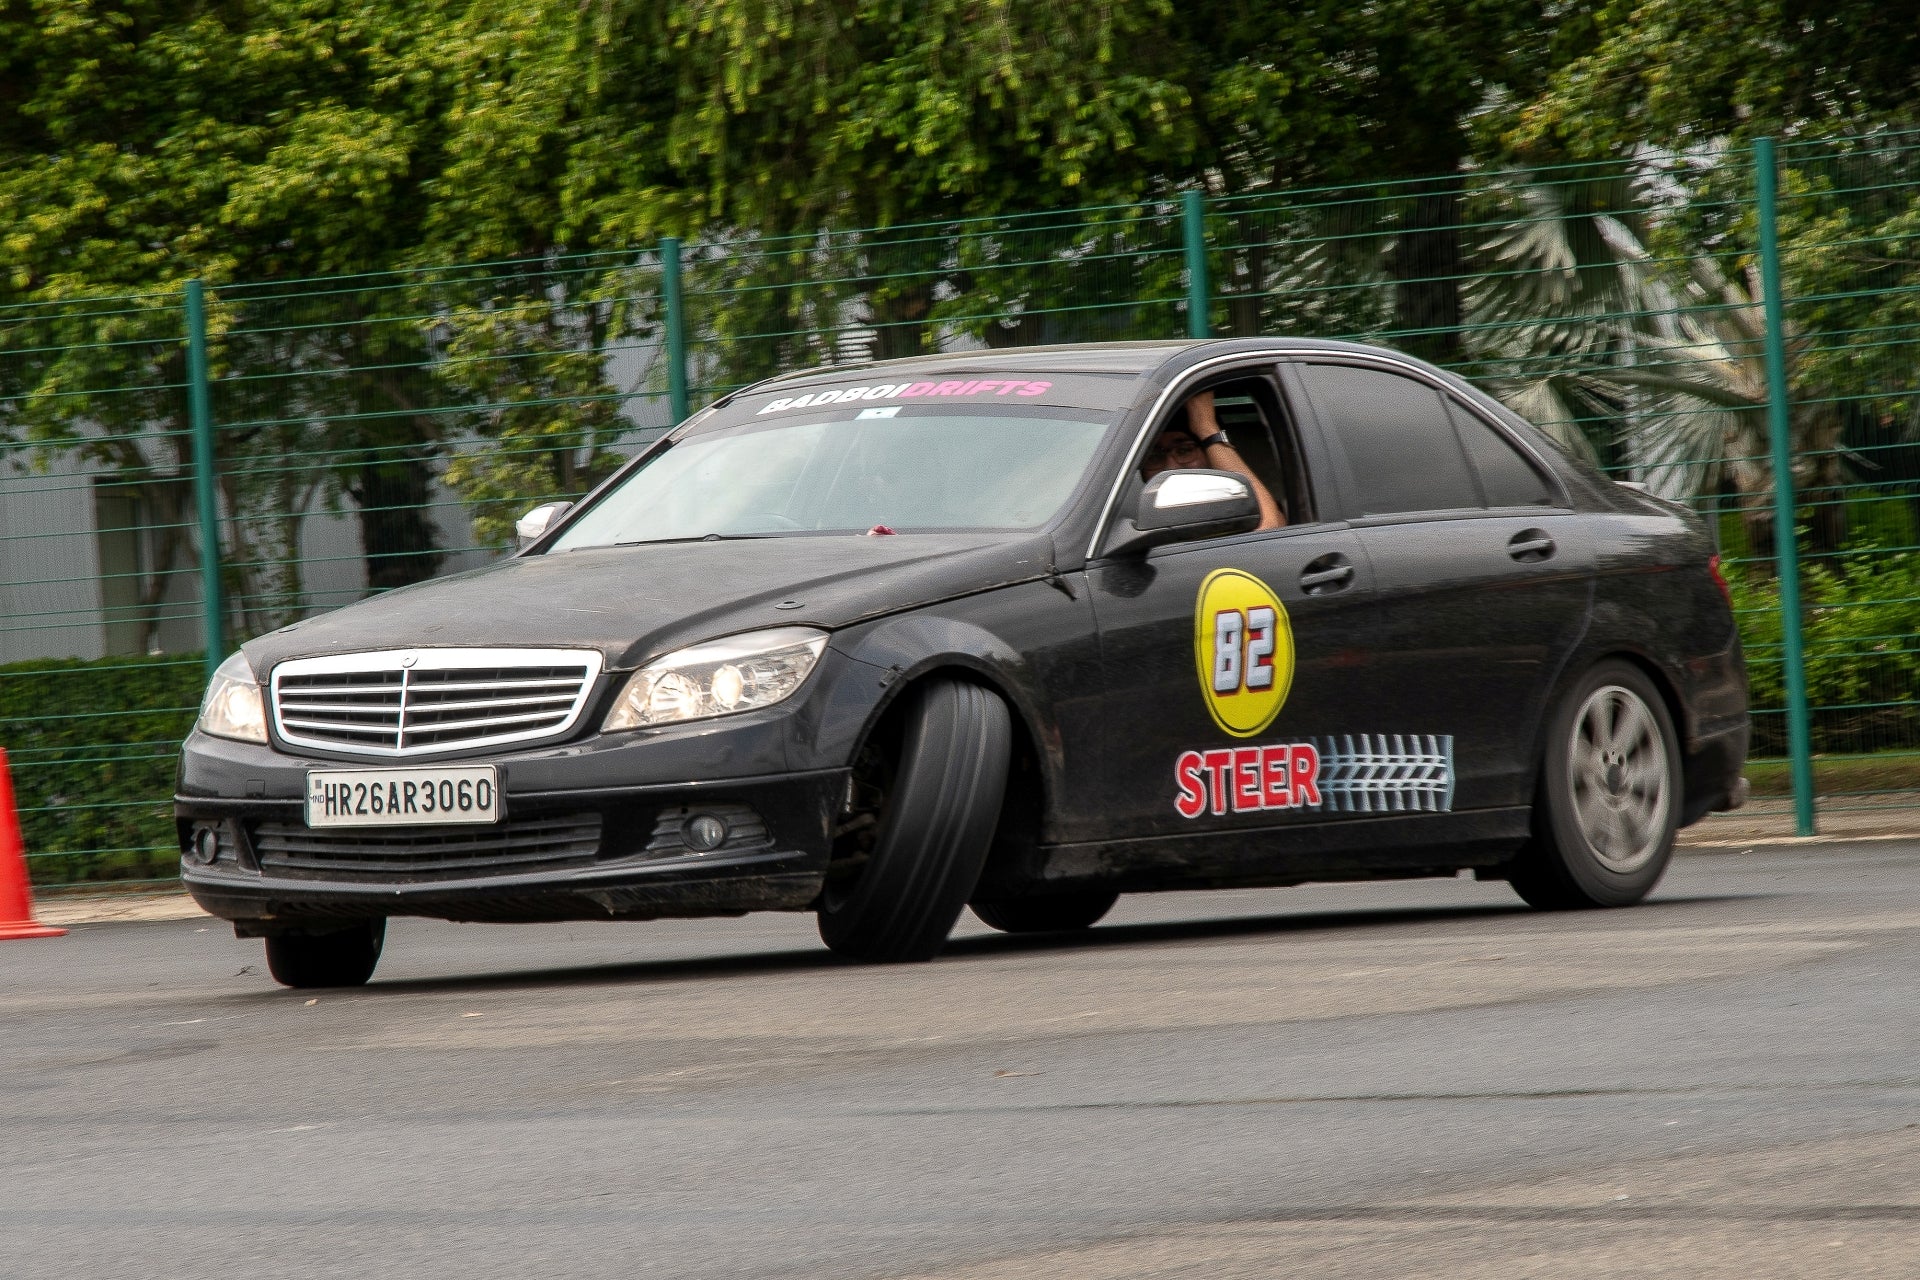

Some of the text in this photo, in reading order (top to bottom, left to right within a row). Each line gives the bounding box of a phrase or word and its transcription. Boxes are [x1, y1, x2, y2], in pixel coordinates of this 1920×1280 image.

[1213, 606, 1276, 697] 82
[324, 778, 491, 816] HR26AR3060
[1174, 743, 1322, 819] STEER
